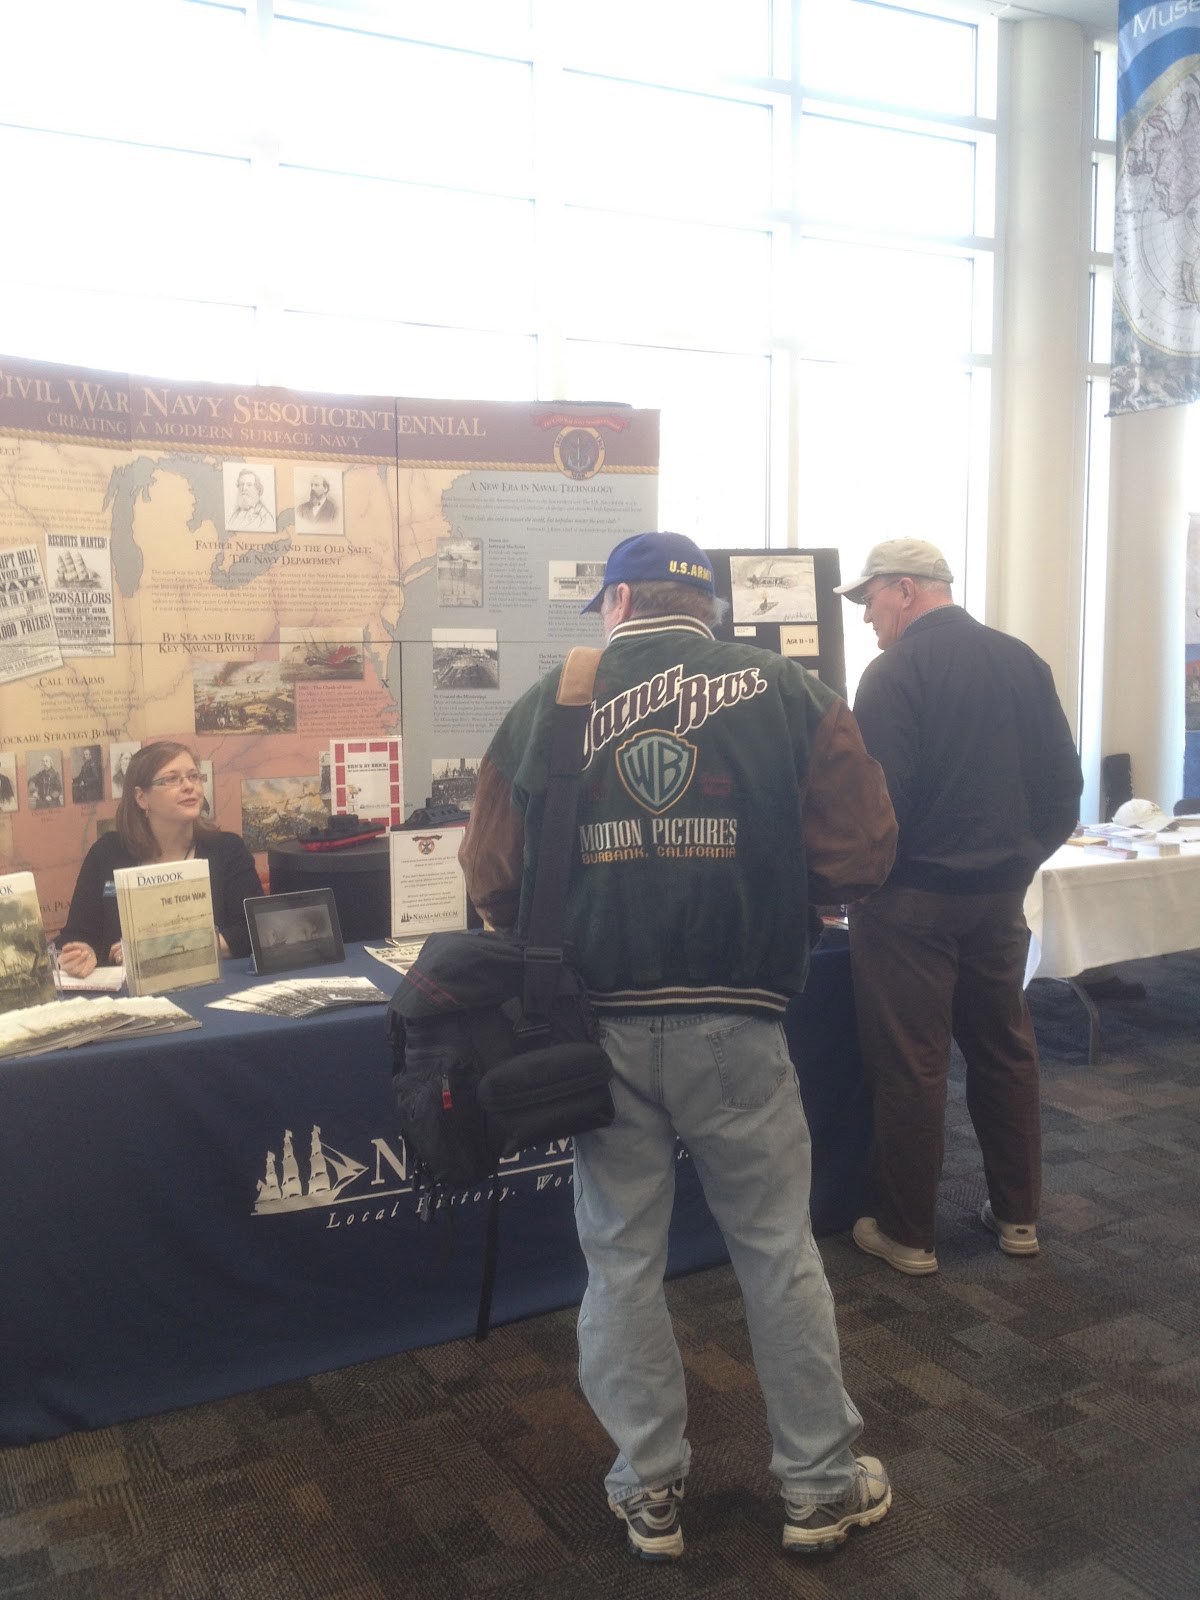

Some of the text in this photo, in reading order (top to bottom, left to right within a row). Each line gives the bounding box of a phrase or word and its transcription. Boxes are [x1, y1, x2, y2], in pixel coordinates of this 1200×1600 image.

[0, 371, 487, 437] IVIL WAR NAVY SESQUICENTENNIAL
[47, 412, 363, 449] CREATING A MODERN SURFACE NAVY
[469, 482, 477, 491] A
[480, 482, 498, 491] NEW
[502, 482, 518, 492] ERA
[532, 483, 558, 493] NAVAL
[559, 484, 614, 495] TECHNOLOGY
[47, 534, 79, 547] RECRUITS
[195, 540, 233, 551] FATHER
[236, 541, 281, 552] NEPTUNE
[282, 543, 301, 553] AND
[303, 544, 321, 553] THE
[323, 543, 345, 554] OLD
[229, 554, 342, 566] THE NAVY DEPARTMENT
[49, 592, 112, 605] 250 SAILORS
[162, 632, 255, 643] BY SEA AND RIVER:
[159, 643, 259, 654] KEY NAVAL BATTLES
[39, 676, 105, 688] CALL TO ARMS
[582, 663, 768, 771] arner Bros.
[44, 732, 89, 744] STRATEGY
[91, 729, 121, 740] BOARD
[579, 817, 738, 853] MOTION PICTURES
[581, 846, 737, 865] BURBANK, CALIFORNIA
[136, 872, 184, 887] DAYBOOK
[160, 892, 206, 907] THE TECH WAR
[326, 1201, 399, 1230] Local
